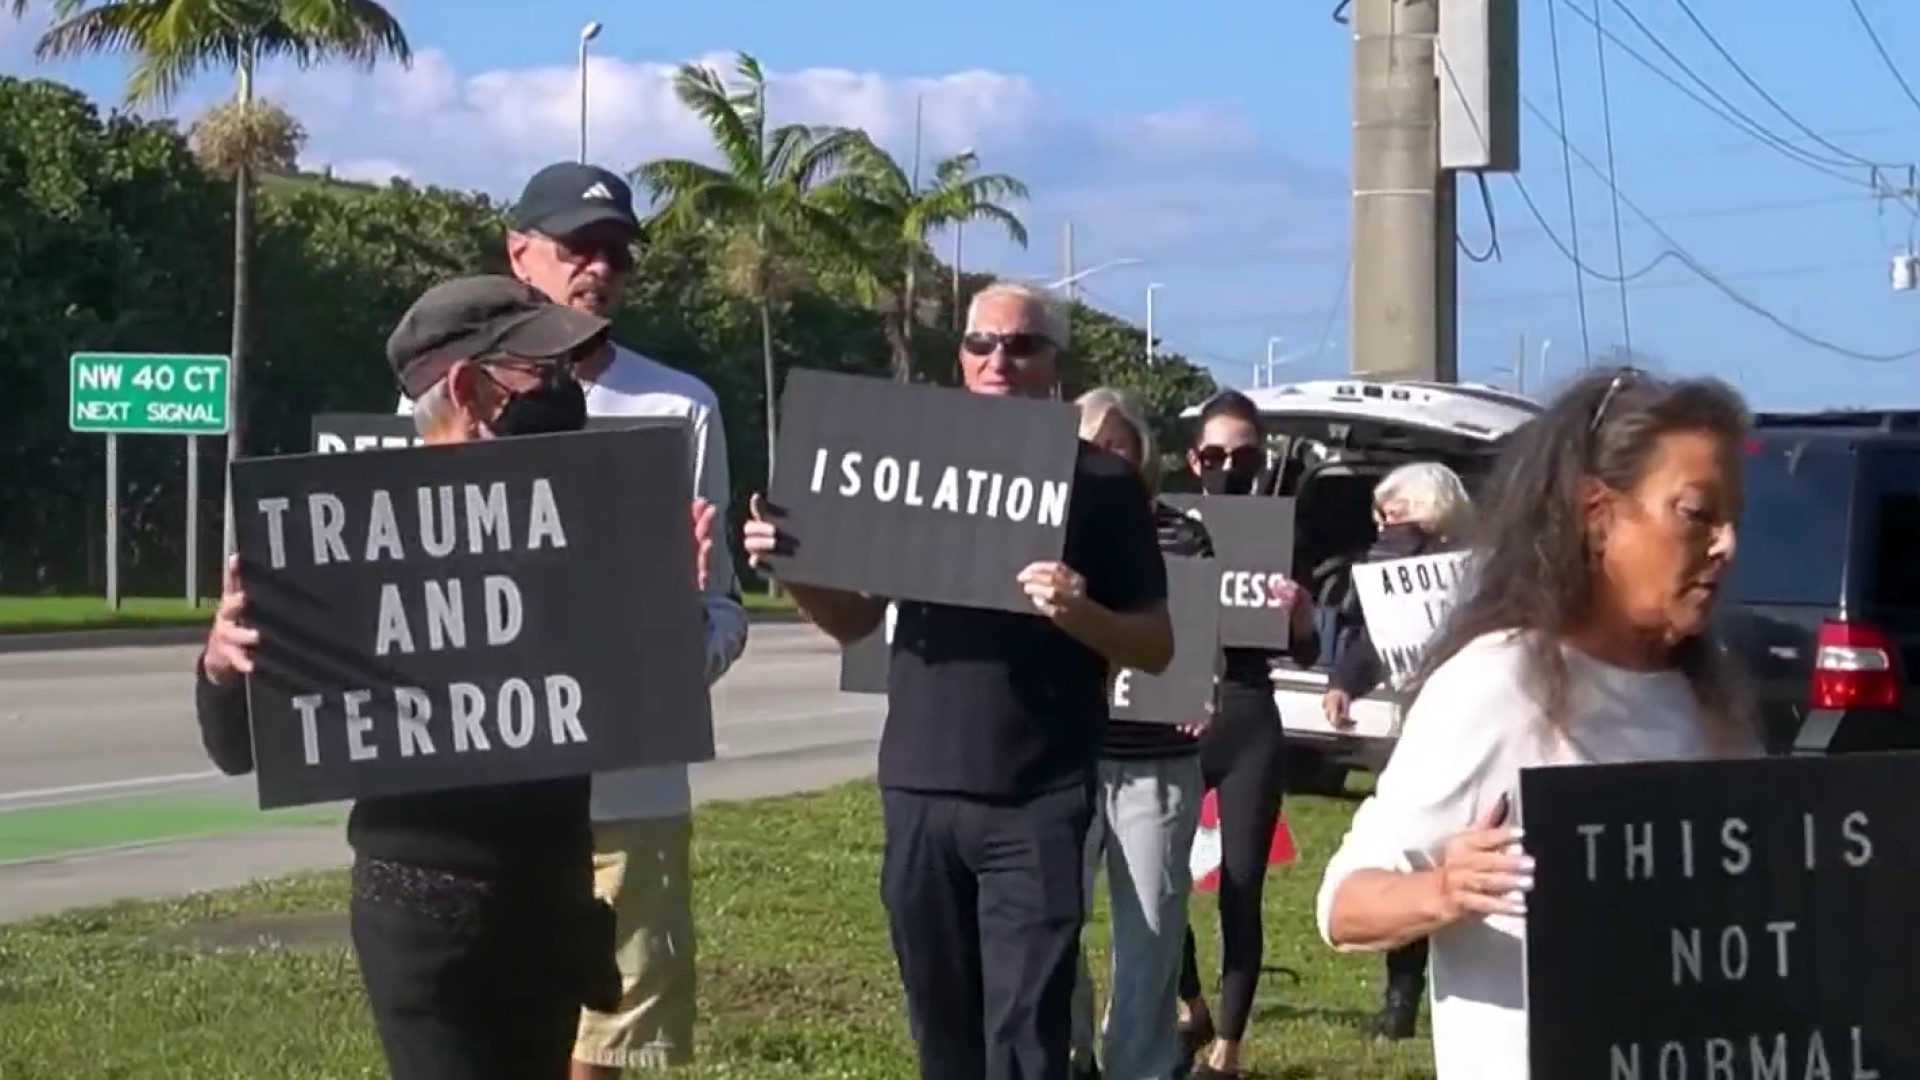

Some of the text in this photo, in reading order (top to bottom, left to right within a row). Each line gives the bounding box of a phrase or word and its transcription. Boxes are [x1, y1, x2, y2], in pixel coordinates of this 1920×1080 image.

[76, 400, 222, 424] NEXT SIGNAL
[78, 363, 222, 393] NW 40 CT
[257, 477, 568, 569] TRAUMA
[810, 448, 1069, 528] ISOLATION
[375, 574, 524, 657] AND
[291, 673, 589, 766] TERROR
[1577, 811, 1874, 881] THIS IS
[1671, 920, 1797, 985] NOT
[1610, 1026, 1881, 1080] NORMAL
